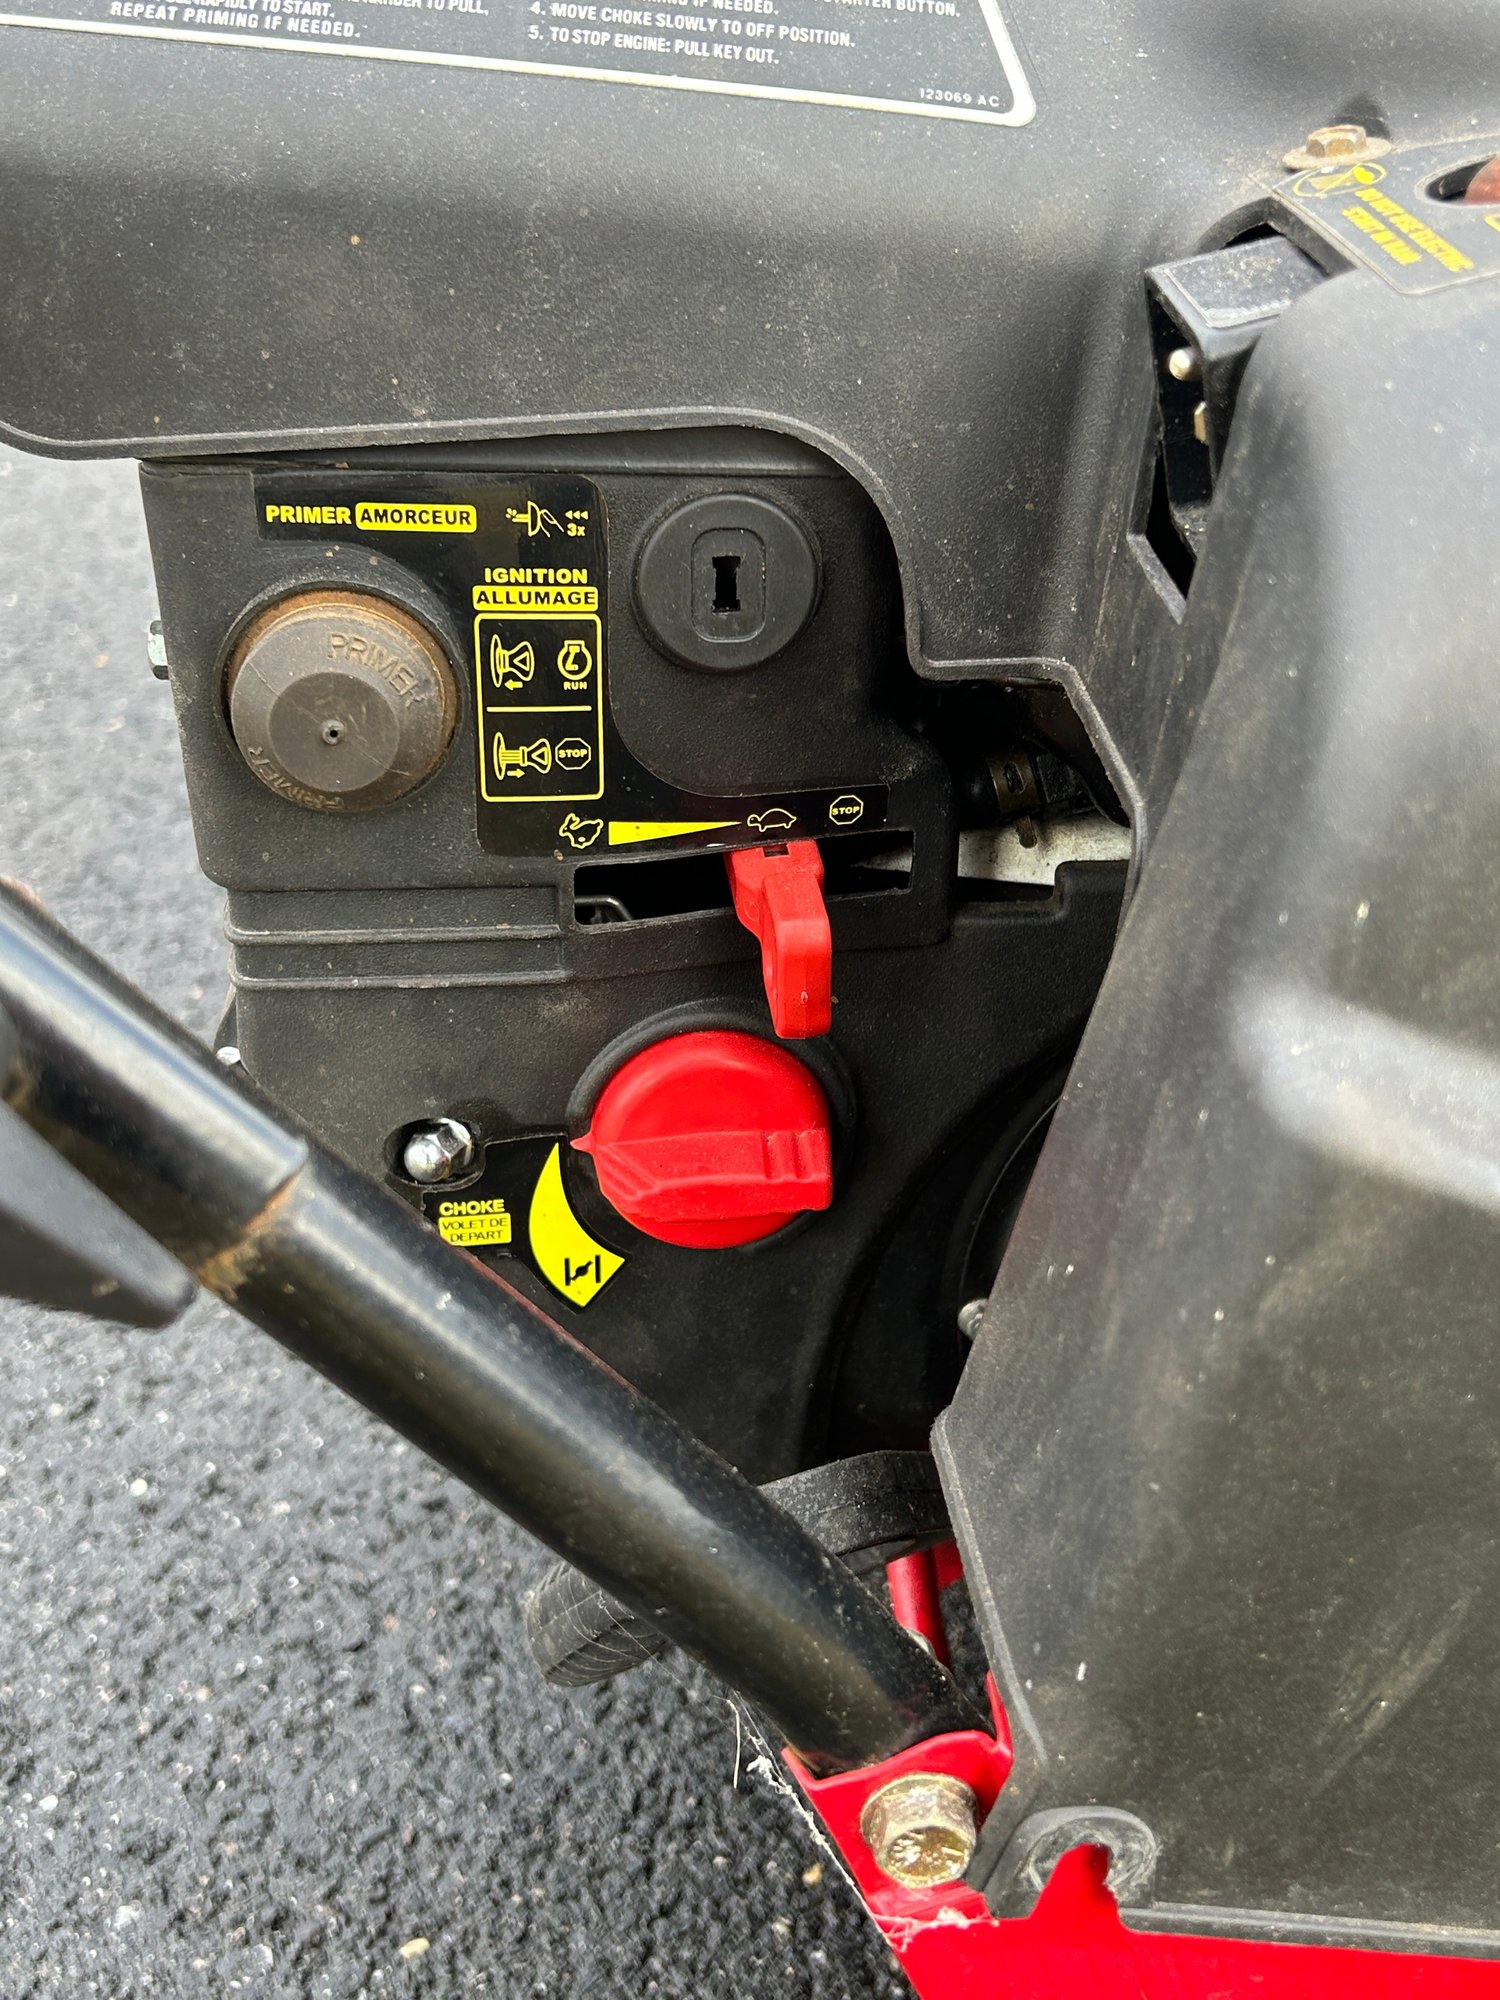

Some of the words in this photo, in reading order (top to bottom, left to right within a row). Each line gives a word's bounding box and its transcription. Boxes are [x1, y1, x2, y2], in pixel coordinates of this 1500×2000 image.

[260, 0, 281, 12] TO
[282, 0, 335, 17] START.
[110, 1, 178, 20] REPEAT
[183, 8, 258, 28] PRIMING
[263, 14, 282, 30] IF
[287, 17, 360, 38] NEEDED.
[530, 1, 546, 15] 4.
[551, 3, 597, 20] MOVE
[601, 7, 652, 26] CHOKE
[656, 13, 718, 32] SLOWLY
[721, 19, 742, 35] TO
[746, 22, 775, 38] OFF
[779, 25, 856, 47] POSITION.
[528, 25, 544, 40] 5.
[550, 27, 570, 42] TO
[572, 29, 611, 46] STOP
[614, 33, 671, 53] ENGINE:
[675, 39, 710, 56] PULL
[713, 43, 743, 60] KEY
[746, 47, 780, 64] OUT.
[920, 88, 972, 104] 123069
[978, 95, 1000, 107] AC
[266, 505, 352, 524] PRIMER
[361, 508, 471, 525] AMORCEUR
[567, 523, 586, 537] 3x
[484, 567, 588, 584] IGNITION
[477, 591, 596, 605] ALLUMAGE
[563, 681, 588, 691] RUN
[558, 748, 588, 759] STOP
[832, 806, 860, 815] STOP
[439, 1199, 505, 1216] CHOKE
[442, 1219, 486, 1230] VOLET
[489, 1217, 509, 1228] DE
[450, 1230, 503, 1242] DEPART
